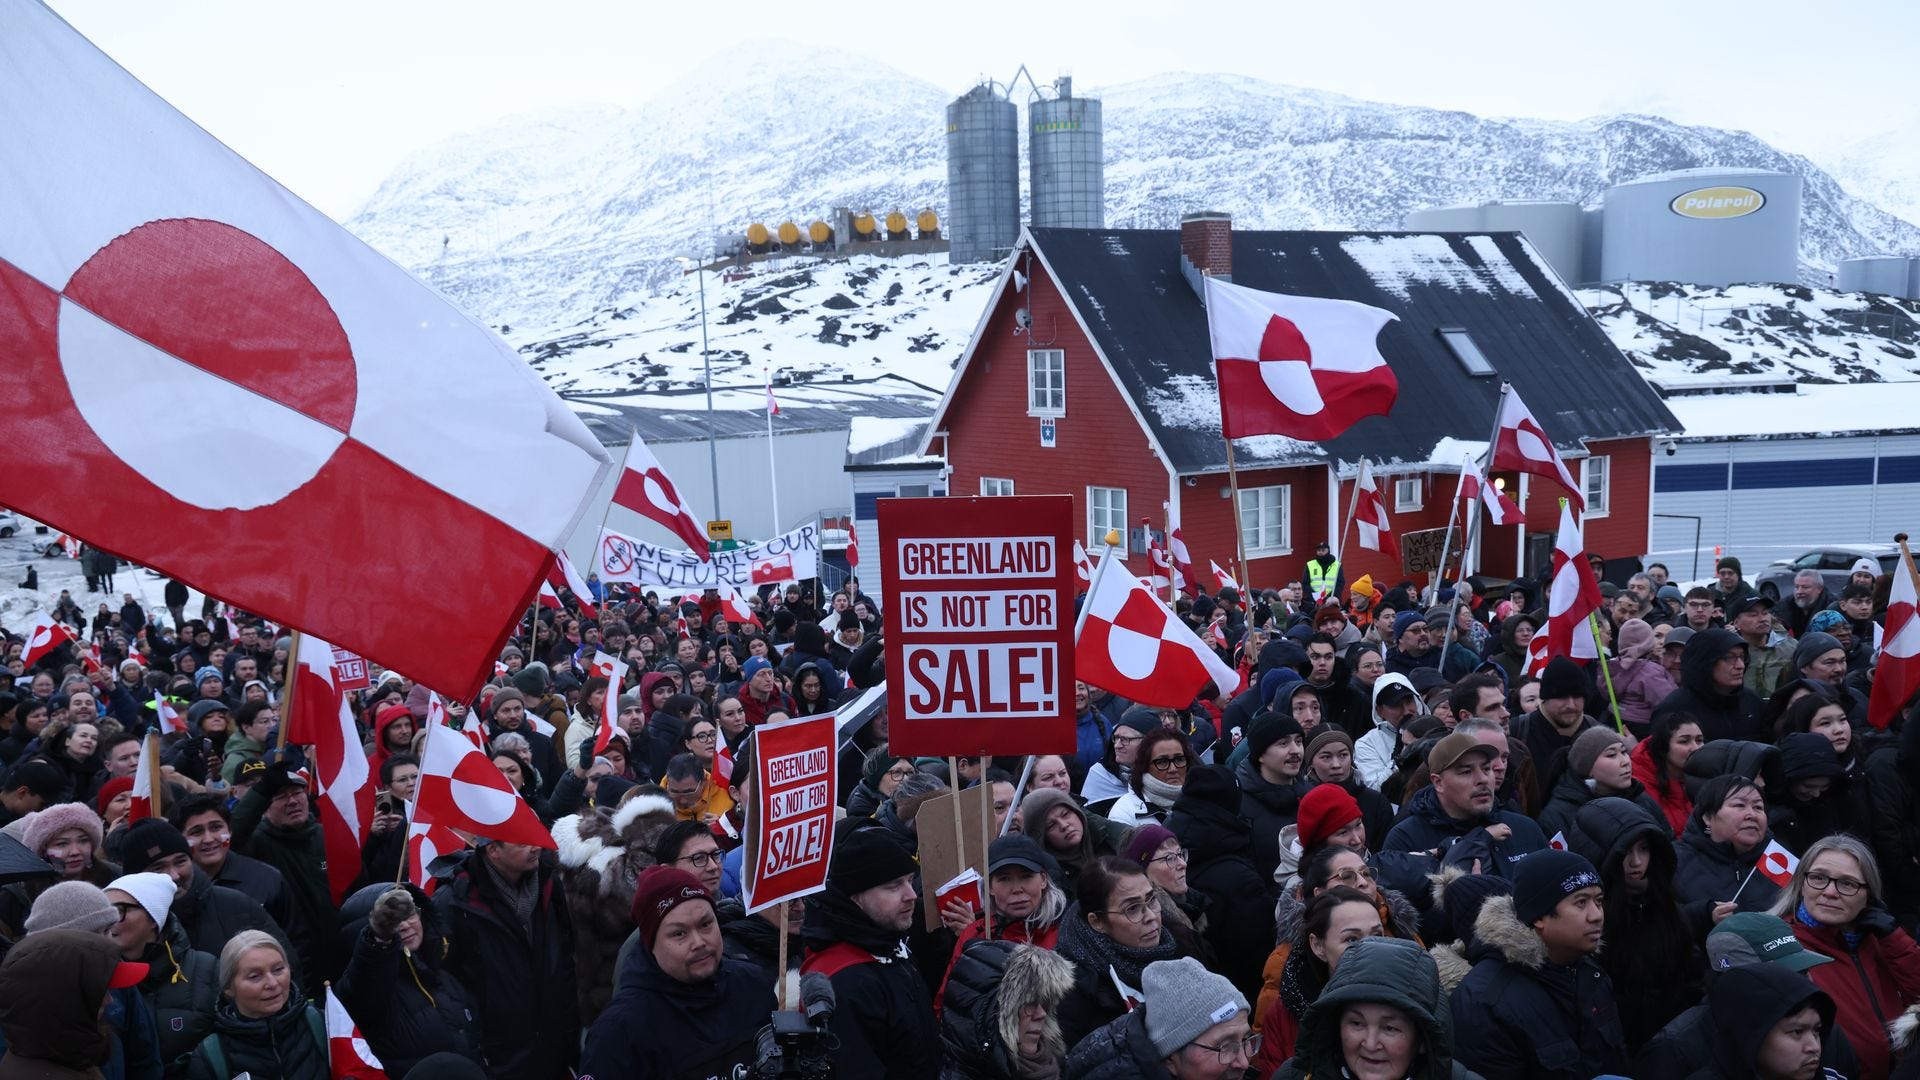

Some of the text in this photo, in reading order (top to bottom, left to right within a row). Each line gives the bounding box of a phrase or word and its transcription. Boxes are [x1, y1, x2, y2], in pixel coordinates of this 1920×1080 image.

[1685, 195, 1754, 209] Polaroil
[630, 541, 672, 563] WE
[767, 526, 816, 555] OUR
[1408, 532, 1431, 546] WE
[1408, 544, 1431, 557] NOT
[634, 557, 748, 586] FUTURE
[903, 541, 1052, 575] GREENLAND
[1409, 555, 1450, 573] SAL
[904, 594, 1052, 627] IS NOT FOR
[337, 661, 363, 679] ALE!
[908, 647, 1054, 715] SALE!
[770, 750, 826, 783] GREENLAND
[772, 784, 826, 819] IS NOT FOR
[767, 818, 825, 875] SALE!
